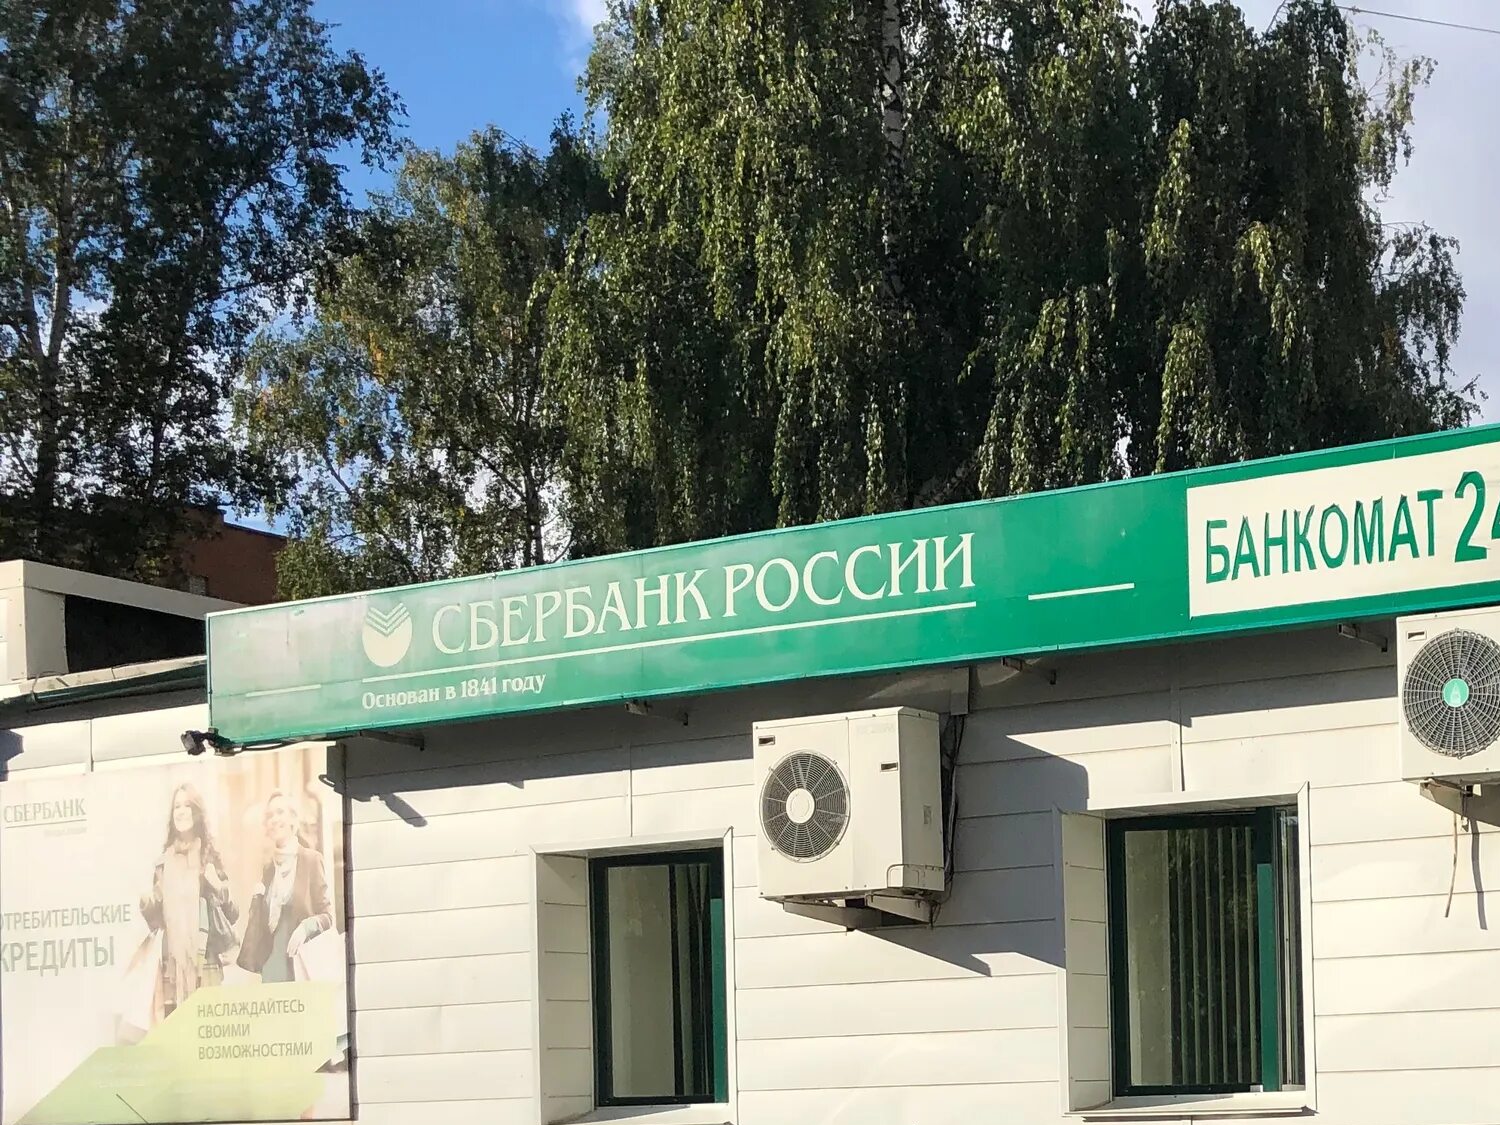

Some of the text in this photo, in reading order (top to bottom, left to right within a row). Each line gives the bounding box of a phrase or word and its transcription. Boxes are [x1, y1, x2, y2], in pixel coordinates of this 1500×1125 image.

[1206, 488, 1444, 584] БАНКОМАТ
[431, 532, 976, 655] СБЕРБАНК РОССИИ
[361, 673, 546, 710] Основан в 1841 году
[3, 798, 87, 824] СБЕРБАНК
[0, 904, 131, 932] ТРЕБИТЕЛЬСКИЕ
[197, 998, 305, 1018] НАСЛАЖДАЙТЕСЬ
[198, 1023, 251, 1039] СВОИМИ
[198, 1041, 313, 1060] ВОЗМОЖНОСТЯМИ
